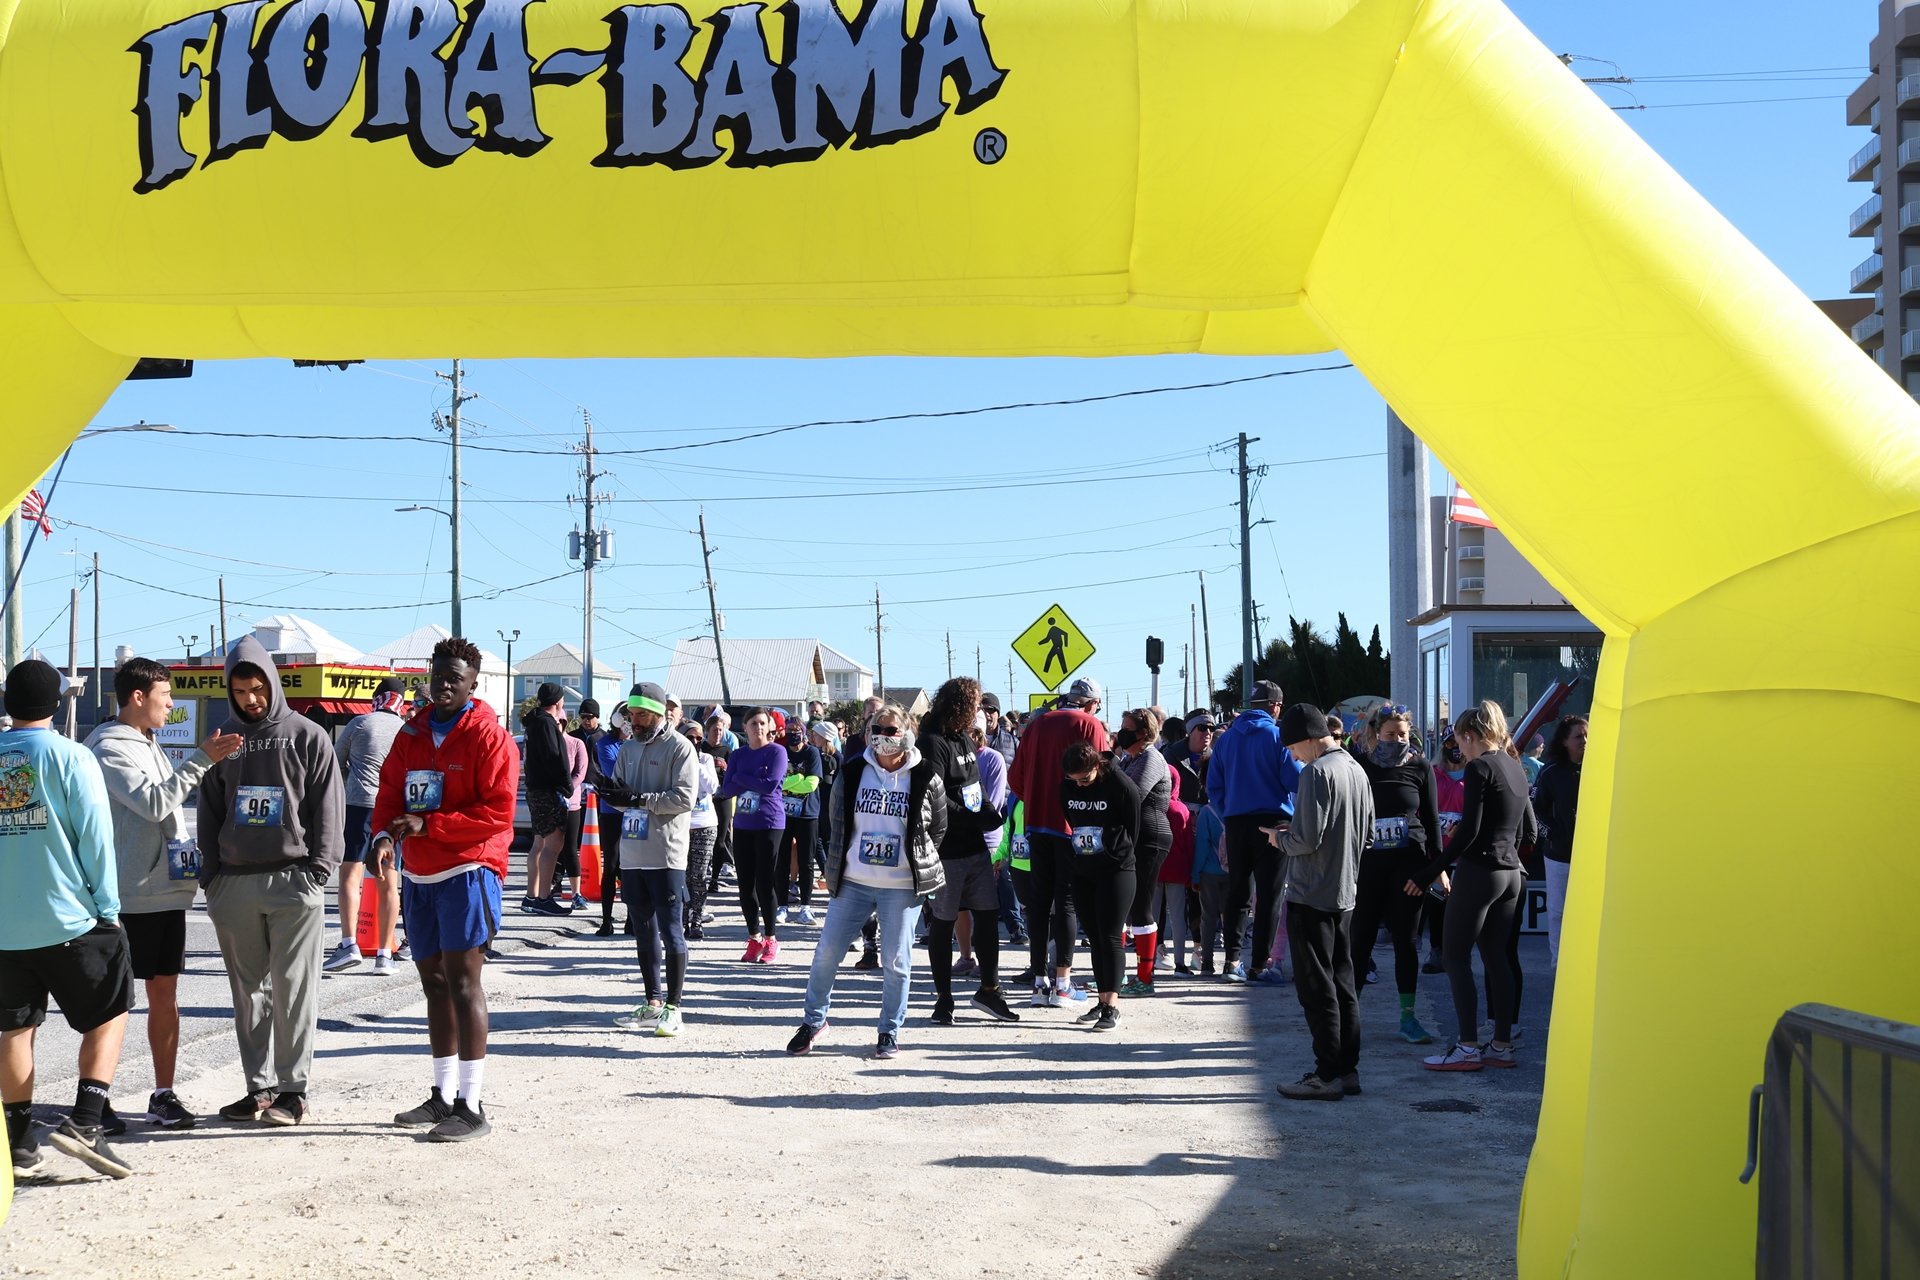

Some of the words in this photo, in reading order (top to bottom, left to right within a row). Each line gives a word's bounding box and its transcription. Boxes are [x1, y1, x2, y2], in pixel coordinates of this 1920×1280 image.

[129, 0, 1010, 194] FLORA-BAMA
[174, 676, 227, 689] WAFFL
[330, 675, 376, 689] WAFFLE
[161, 729, 189, 738] LOTTO
[409, 783, 429, 802] 97
[861, 788, 911, 803] WESTERN
[248, 798, 271, 818] 96
[741, 797, 752, 809] 29
[855, 800, 909, 818] MICHIGAN
[14, 812, 28, 826] THE
[29, 805, 48, 825] LINE
[628, 818, 640, 833] 10
[1079, 834, 1093, 848] 39
[1376, 826, 1402, 841] 119
[865, 842, 894, 859] 218
[1014, 841, 1025, 853] 35
[180, 851, 196, 870] 94
